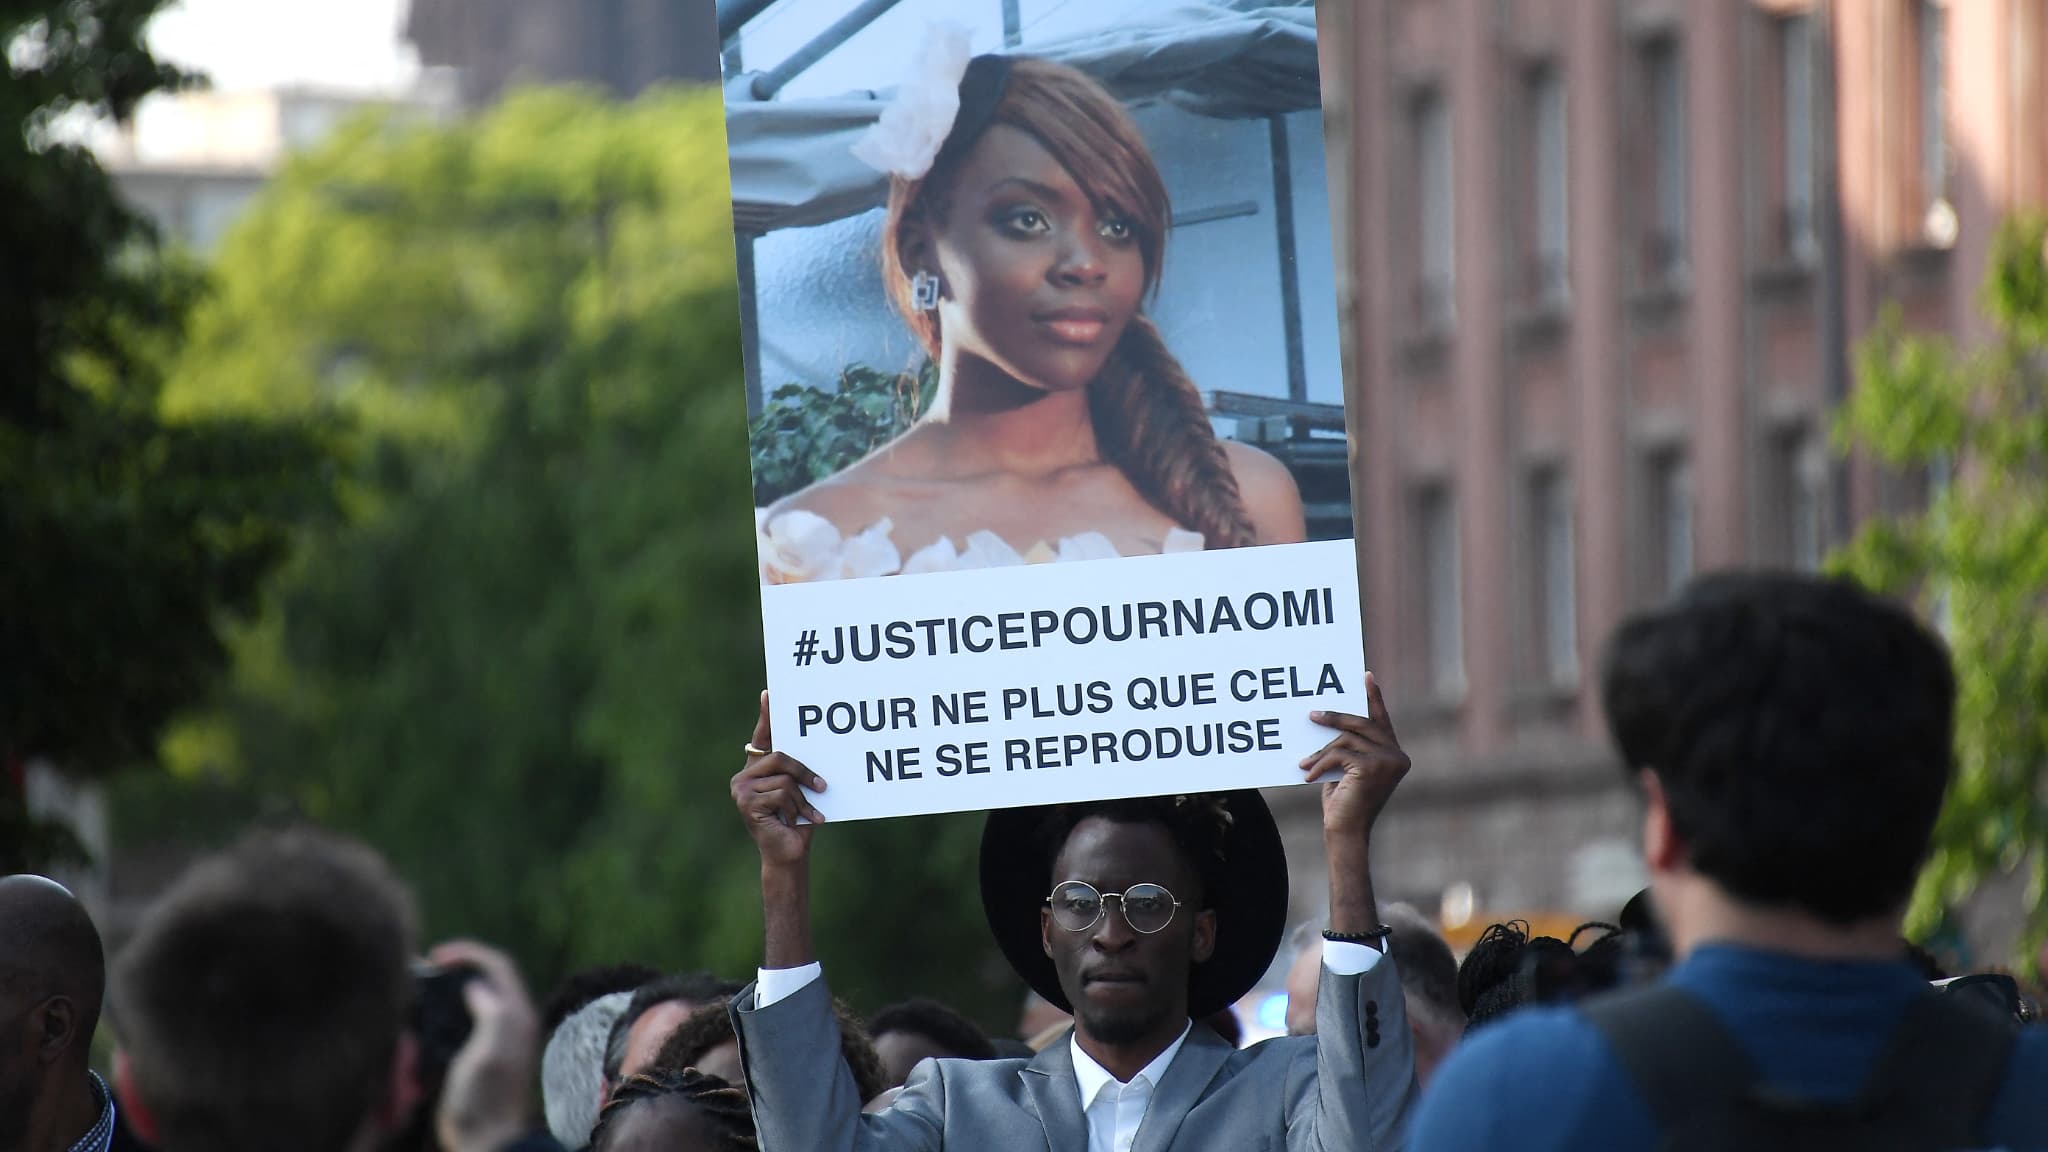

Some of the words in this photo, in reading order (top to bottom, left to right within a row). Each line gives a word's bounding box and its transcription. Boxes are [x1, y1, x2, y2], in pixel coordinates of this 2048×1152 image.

[792, 587, 1335, 667] #JUSTICEPOURNAOMI
[798, 697, 918, 737] POUR
[932, 693, 989, 727] NE
[1002, 680, 1114, 721] PLUS
[1126, 672, 1217, 711] QUE
[1230, 663, 1345, 702] CELA
[865, 747, 923, 783] NE
[935, 741, 991, 777] SE
[1004, 718, 1283, 772] REPRODUISE
